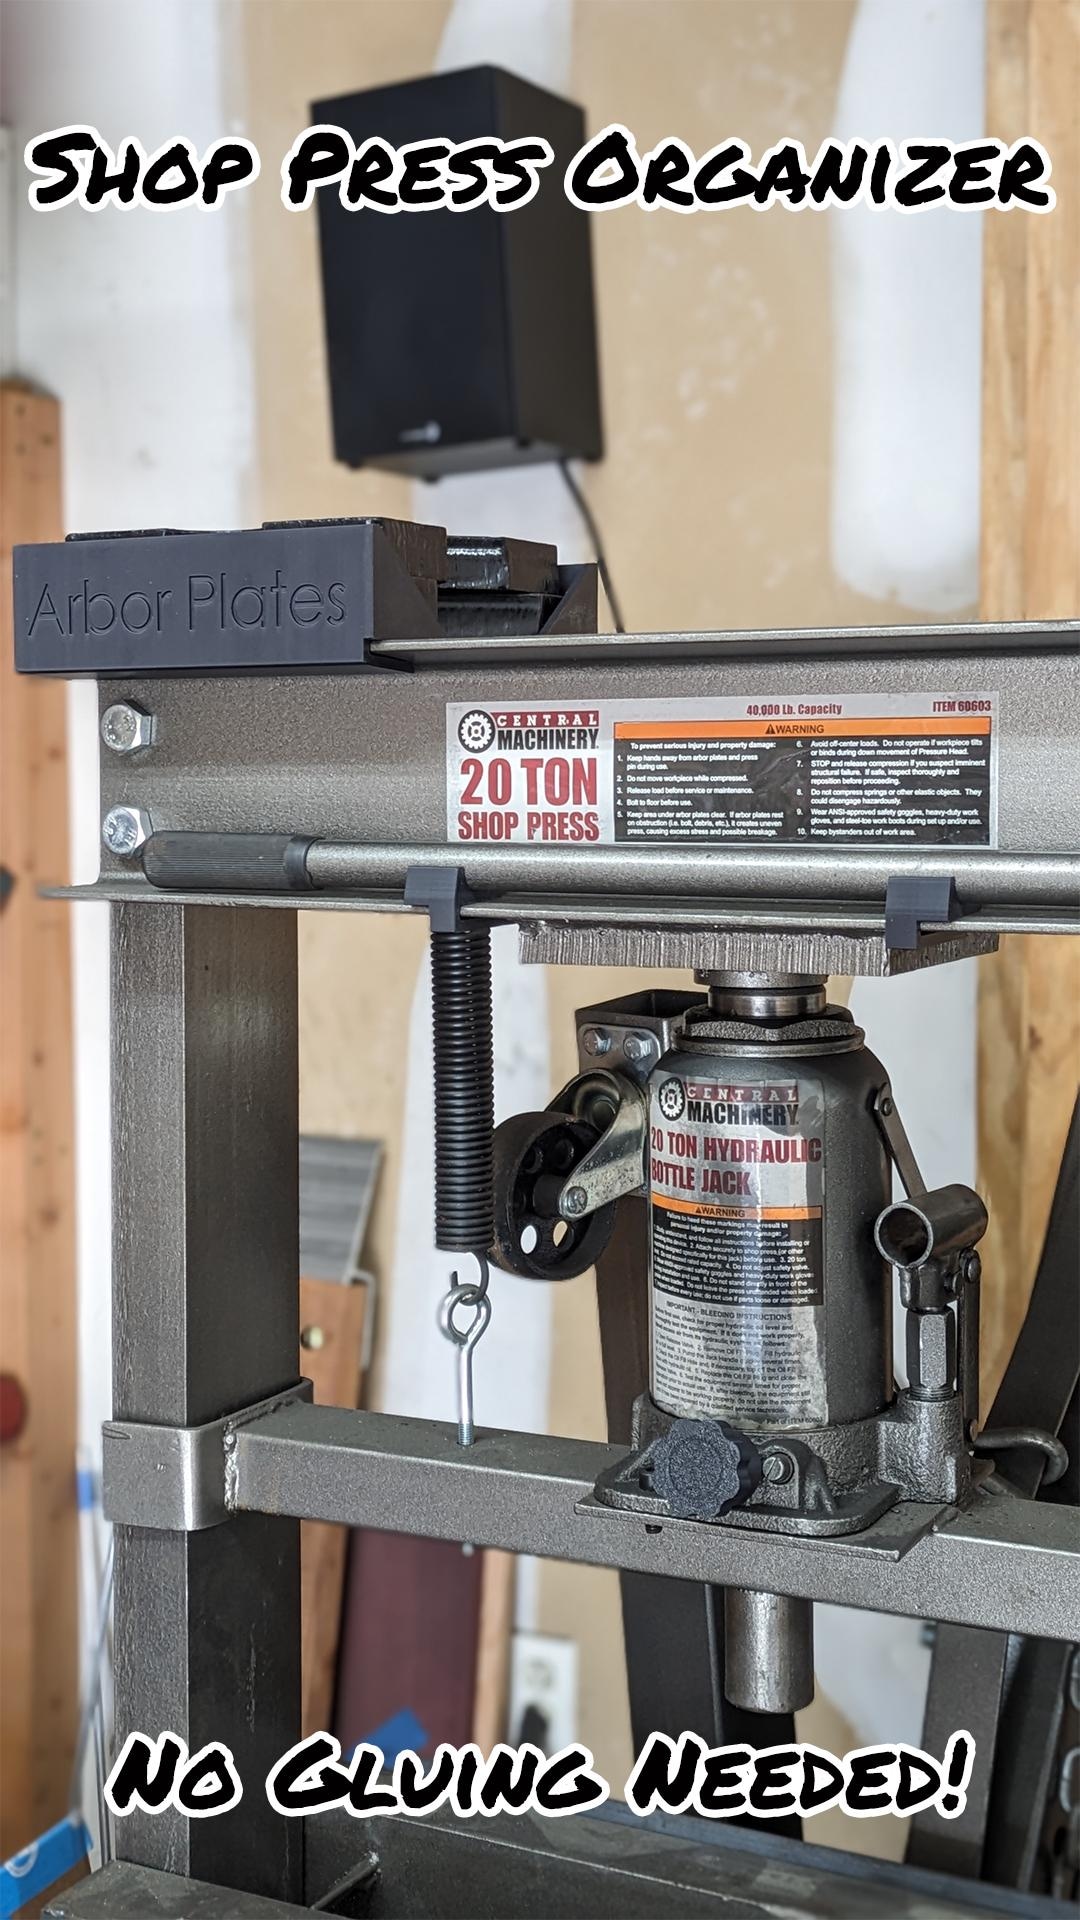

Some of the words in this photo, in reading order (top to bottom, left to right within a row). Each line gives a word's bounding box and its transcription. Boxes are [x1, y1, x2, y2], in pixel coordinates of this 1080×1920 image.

[28, 580, 173, 638] Arbor
[188, 570, 347, 631] Plates
[746, 703, 780, 716] 40,000
[782, 704, 796, 714] Lb.
[798, 703, 842, 715] Capacity
[933, 701, 957, 713] ITEM
[958, 700, 992, 712] 60603
[497, 714, 597, 726] CENTRAL
[775, 724, 824, 735] WARNING
[497, 728, 598, 750] MACHINERY
[905, 740, 930, 748] operate
[688, 742, 706, 750] injury
[720, 742, 747, 750] property
[837, 749, 856, 757] during
[627, 755, 642, 763] Keep
[709, 754, 727, 762] plates
[869, 760, 909, 768] compression
[929, 760, 954, 768] suspect
[888, 769, 911, 777] inspect
[912, 769, 945, 777] thoroughly
[460, 757, 512, 806] 20
[520, 757, 597, 806] TON
[664, 775, 693, 783] workpiece
[811, 778, 841, 786] reposition
[863, 778, 900, 786] proceeding.
[864, 789, 887, 797] springs
[936, 789, 961, 797] objects.
[965, 789, 982, 797] They
[862, 798, 902, 806] hazardously.
[627, 811, 642, 819] Keep
[752, 812, 770, 820] plates
[828, 809, 876, 817] ANSI-approved
[877, 809, 896, 817] safety
[897, 809, 924, 817] goggles,
[926, 809, 961, 817] heavy-duty
[457, 811, 519, 840] SHOP
[527, 811, 600, 841] PRESS
[811, 828, 827, 836] Keep
[687, 1086, 797, 1101] CENTRAL
[688, 1101, 798, 1126] MACHINERY
[651, 1126, 663, 1152] 20
[667, 1130, 697, 1159] TON
[704, 1136, 822, 1163] HYDRAULIC
[651, 1157, 695, 1191] BOTTLE
[701, 1168, 752, 1195] JACK
[700, 1206, 745, 1218] WARNING
[726, 1229, 752, 1237] property
[700, 1308, 734, 1318] BLEEDING
[736, 1312, 792, 1321] INSTRUCTIONS
